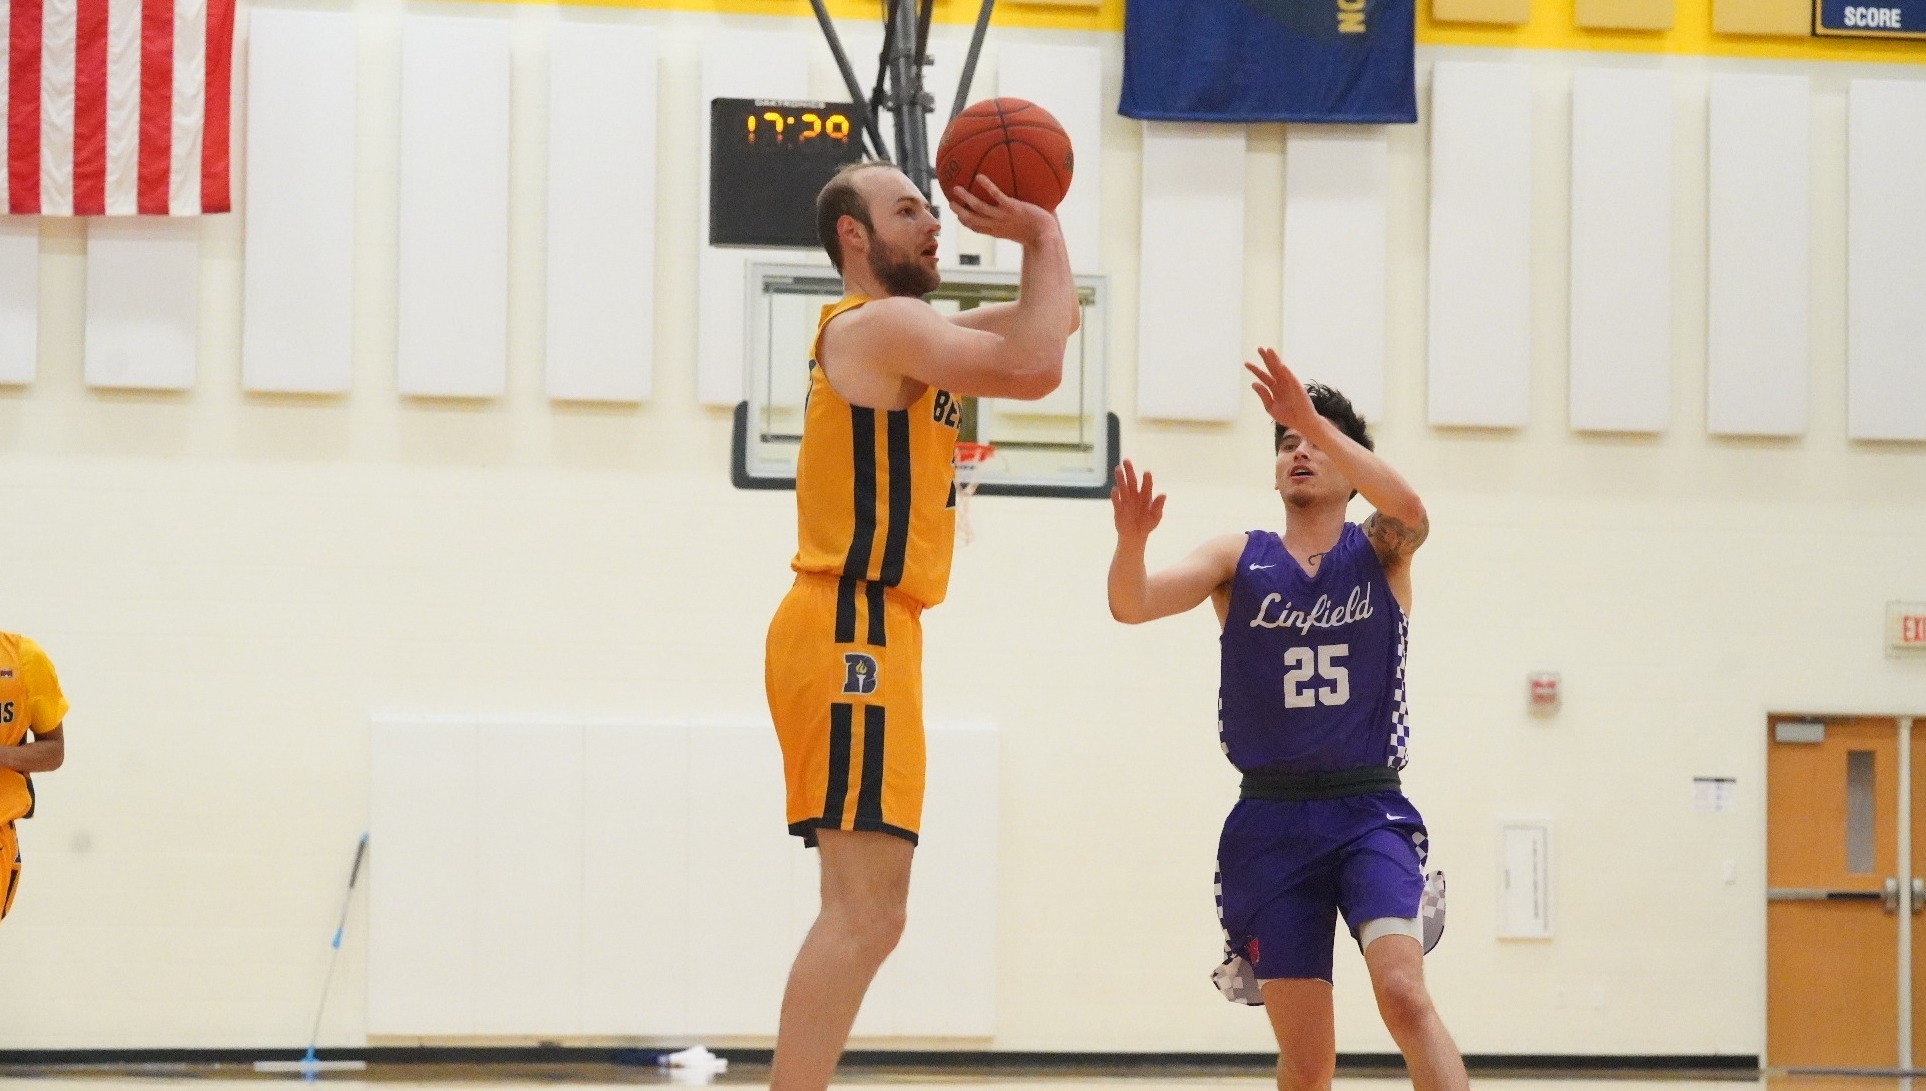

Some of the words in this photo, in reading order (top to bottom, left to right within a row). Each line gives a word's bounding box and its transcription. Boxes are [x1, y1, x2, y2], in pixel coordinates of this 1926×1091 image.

[1844, 6, 1902, 29] SCORE
[1249, 581, 1374, 636] Linfield
[1283, 643, 1351, 709] 25
